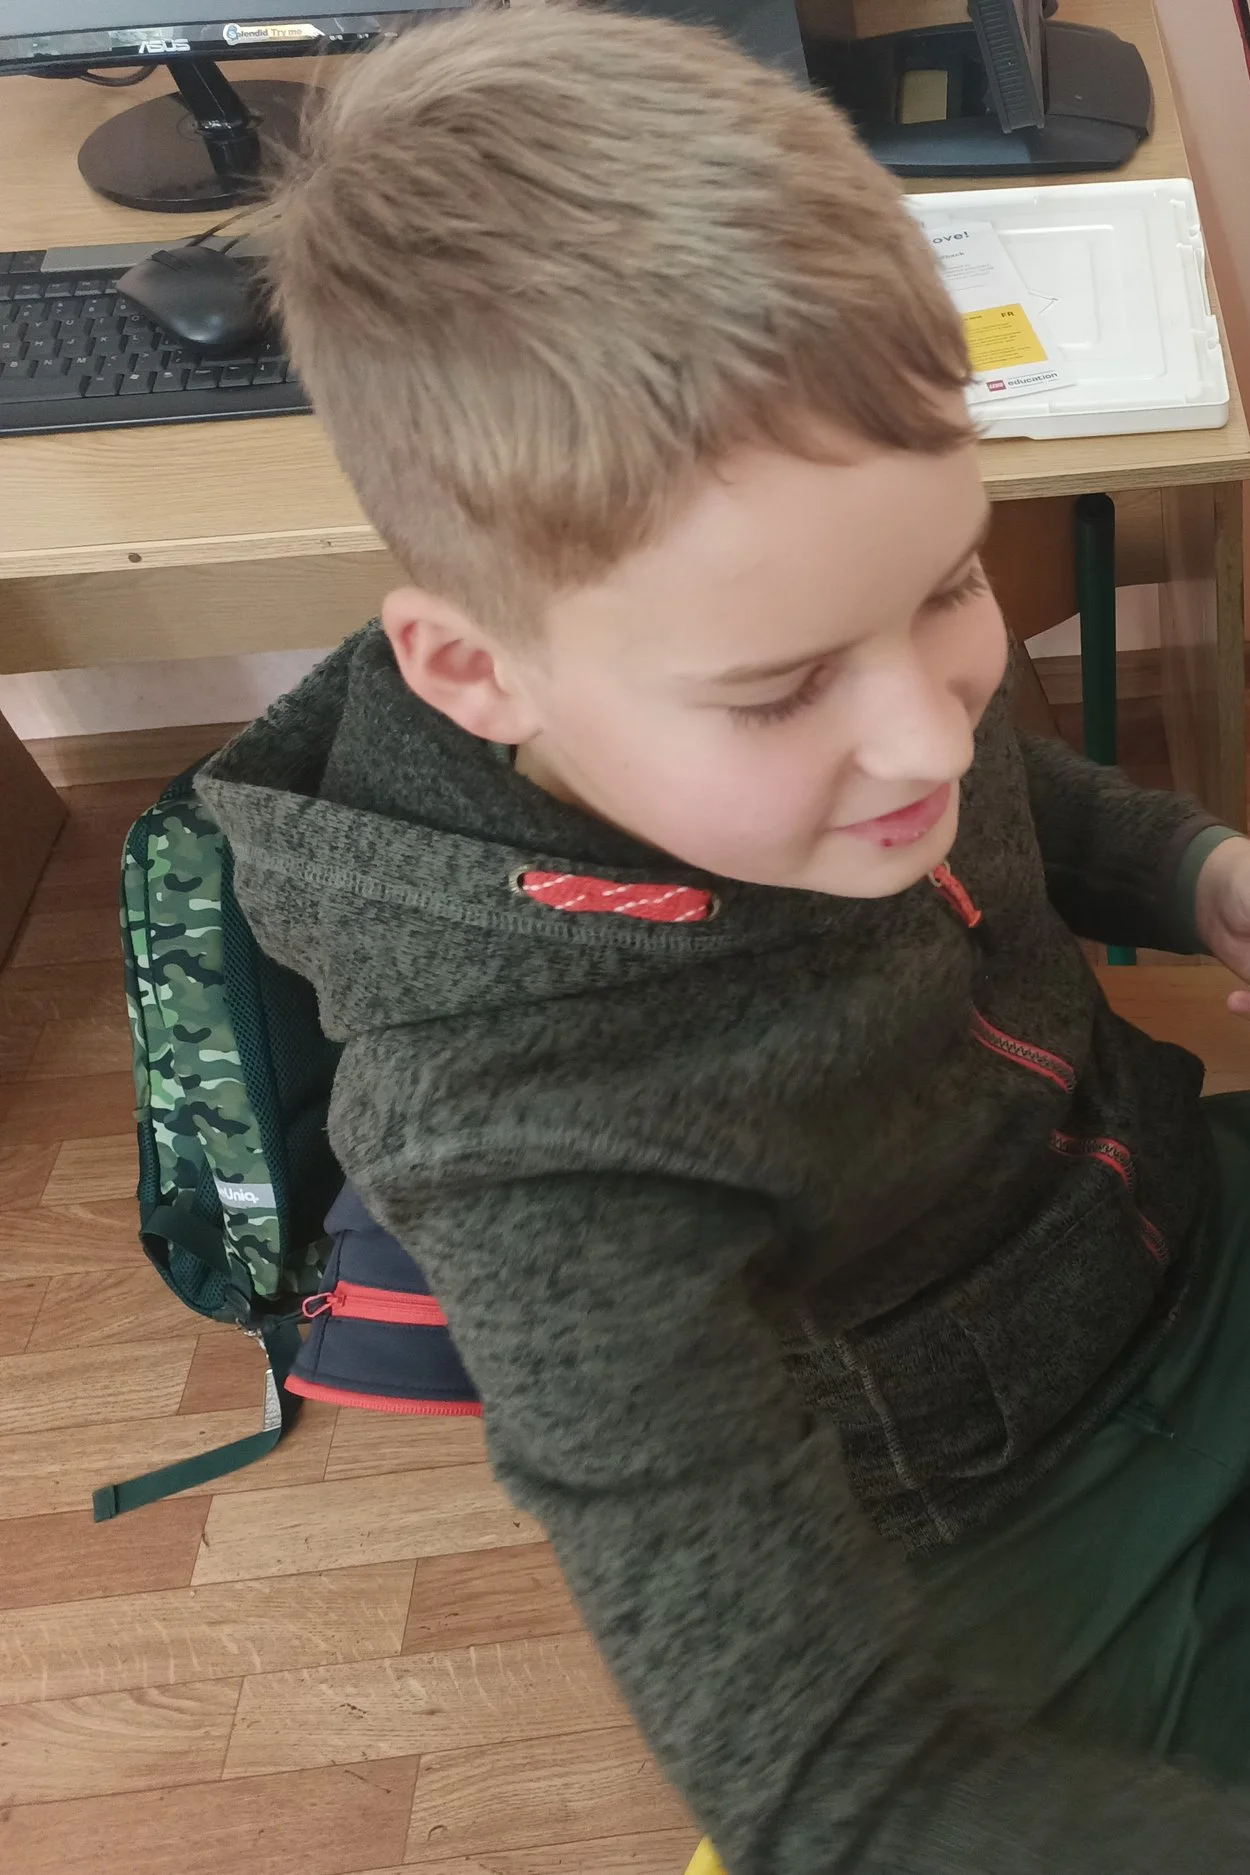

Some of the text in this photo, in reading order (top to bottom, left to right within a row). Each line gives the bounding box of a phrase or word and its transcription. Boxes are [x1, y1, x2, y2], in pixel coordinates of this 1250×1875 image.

[226, 25, 269, 41] Splendid
[271, 28, 286, 37] Try
[138, 38, 191, 53] ASUS
[932, 231, 970, 244] ove!
[1007, 372, 1058, 386] education
